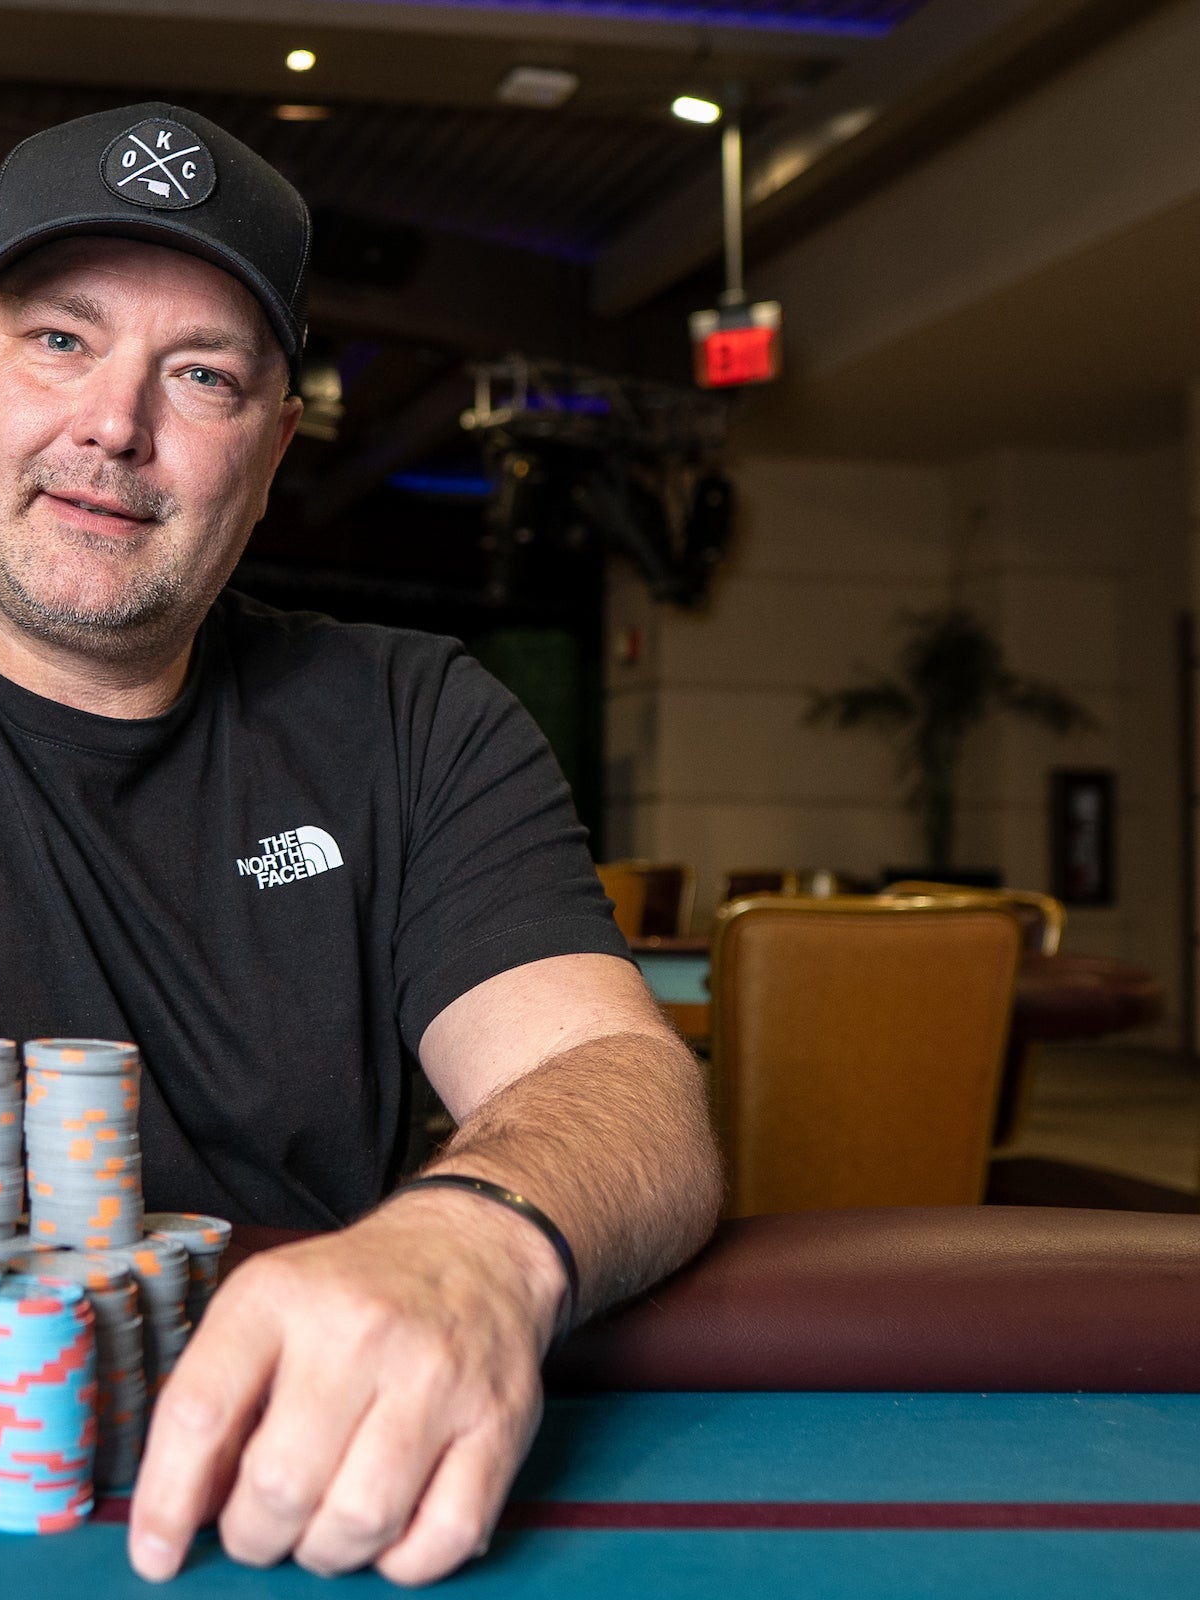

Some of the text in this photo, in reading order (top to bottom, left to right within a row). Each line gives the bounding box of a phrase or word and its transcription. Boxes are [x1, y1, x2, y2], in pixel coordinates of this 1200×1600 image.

[258, 830, 300, 855] THE
[236, 845, 304, 876] NORTH
[257, 862, 308, 890] FACE
